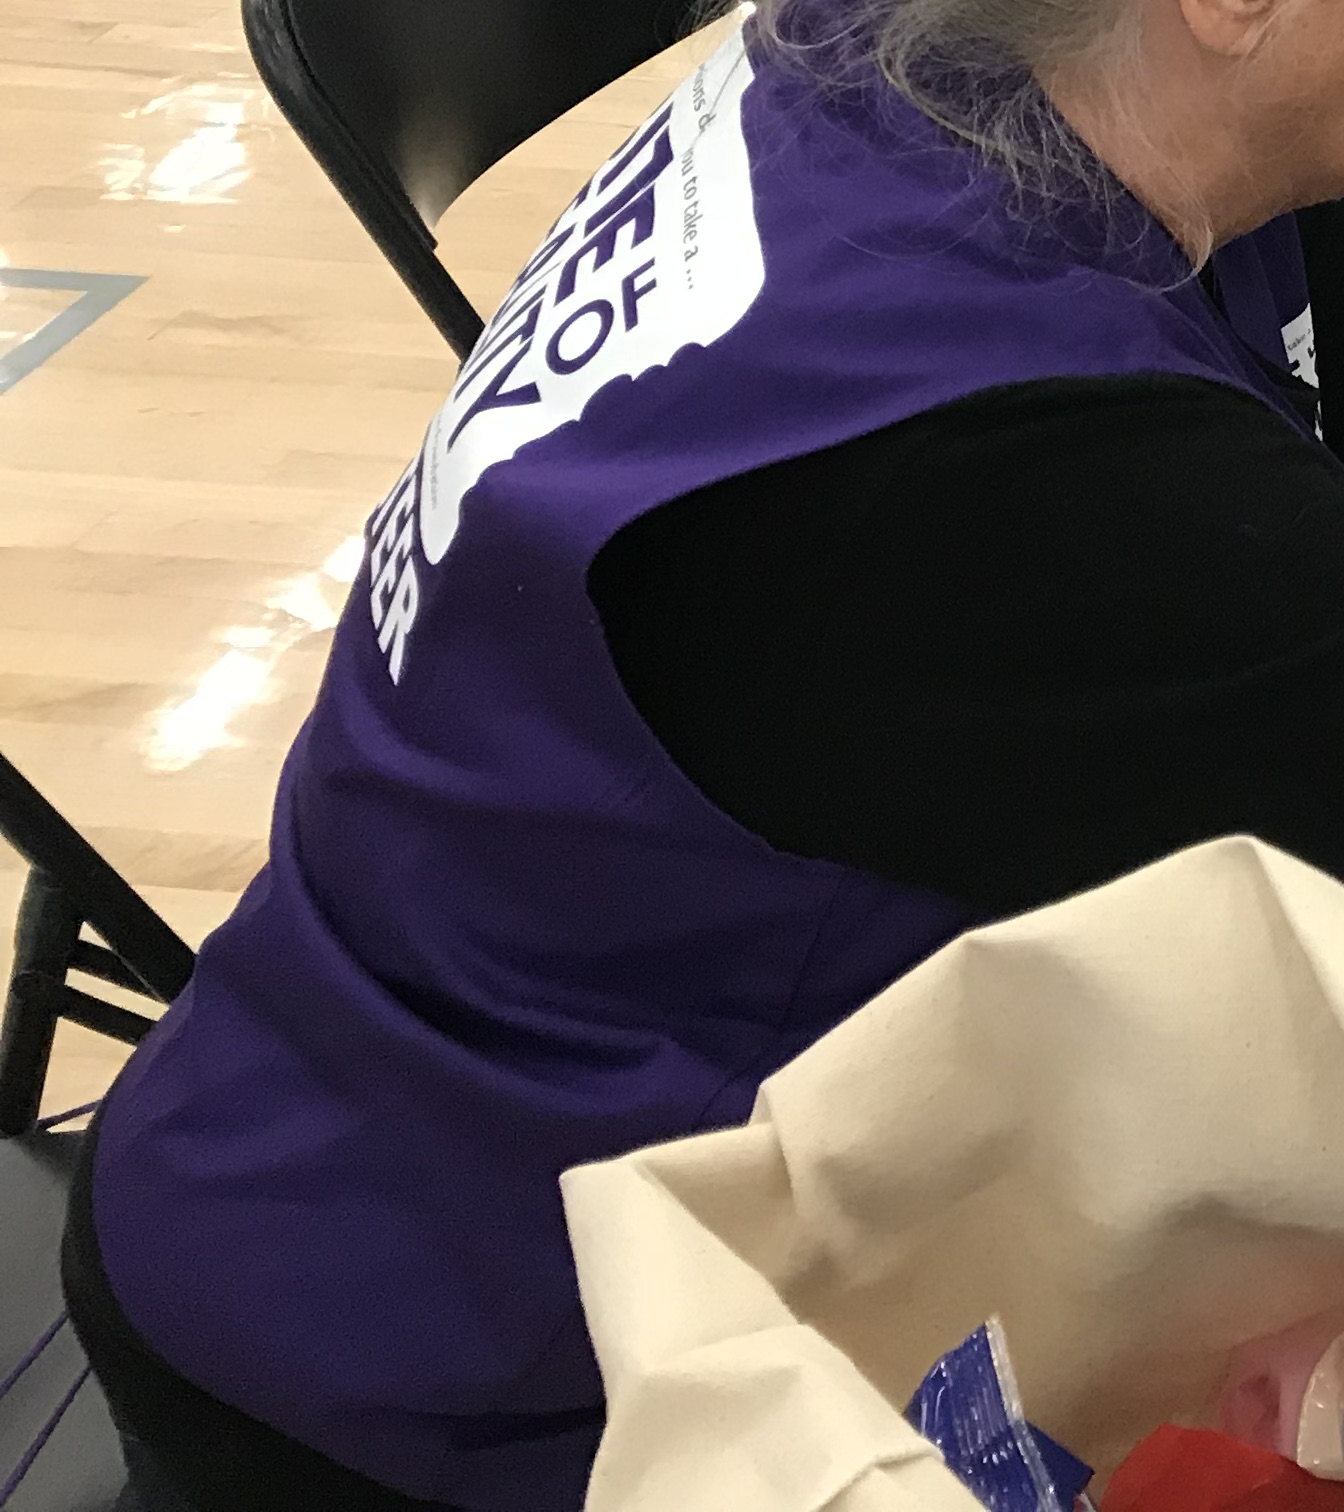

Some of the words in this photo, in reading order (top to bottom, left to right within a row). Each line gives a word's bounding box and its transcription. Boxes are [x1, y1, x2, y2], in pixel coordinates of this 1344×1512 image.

[683, 180, 700, 203] to
[683, 201, 700, 246] take
[683, 246, 695, 263] a
